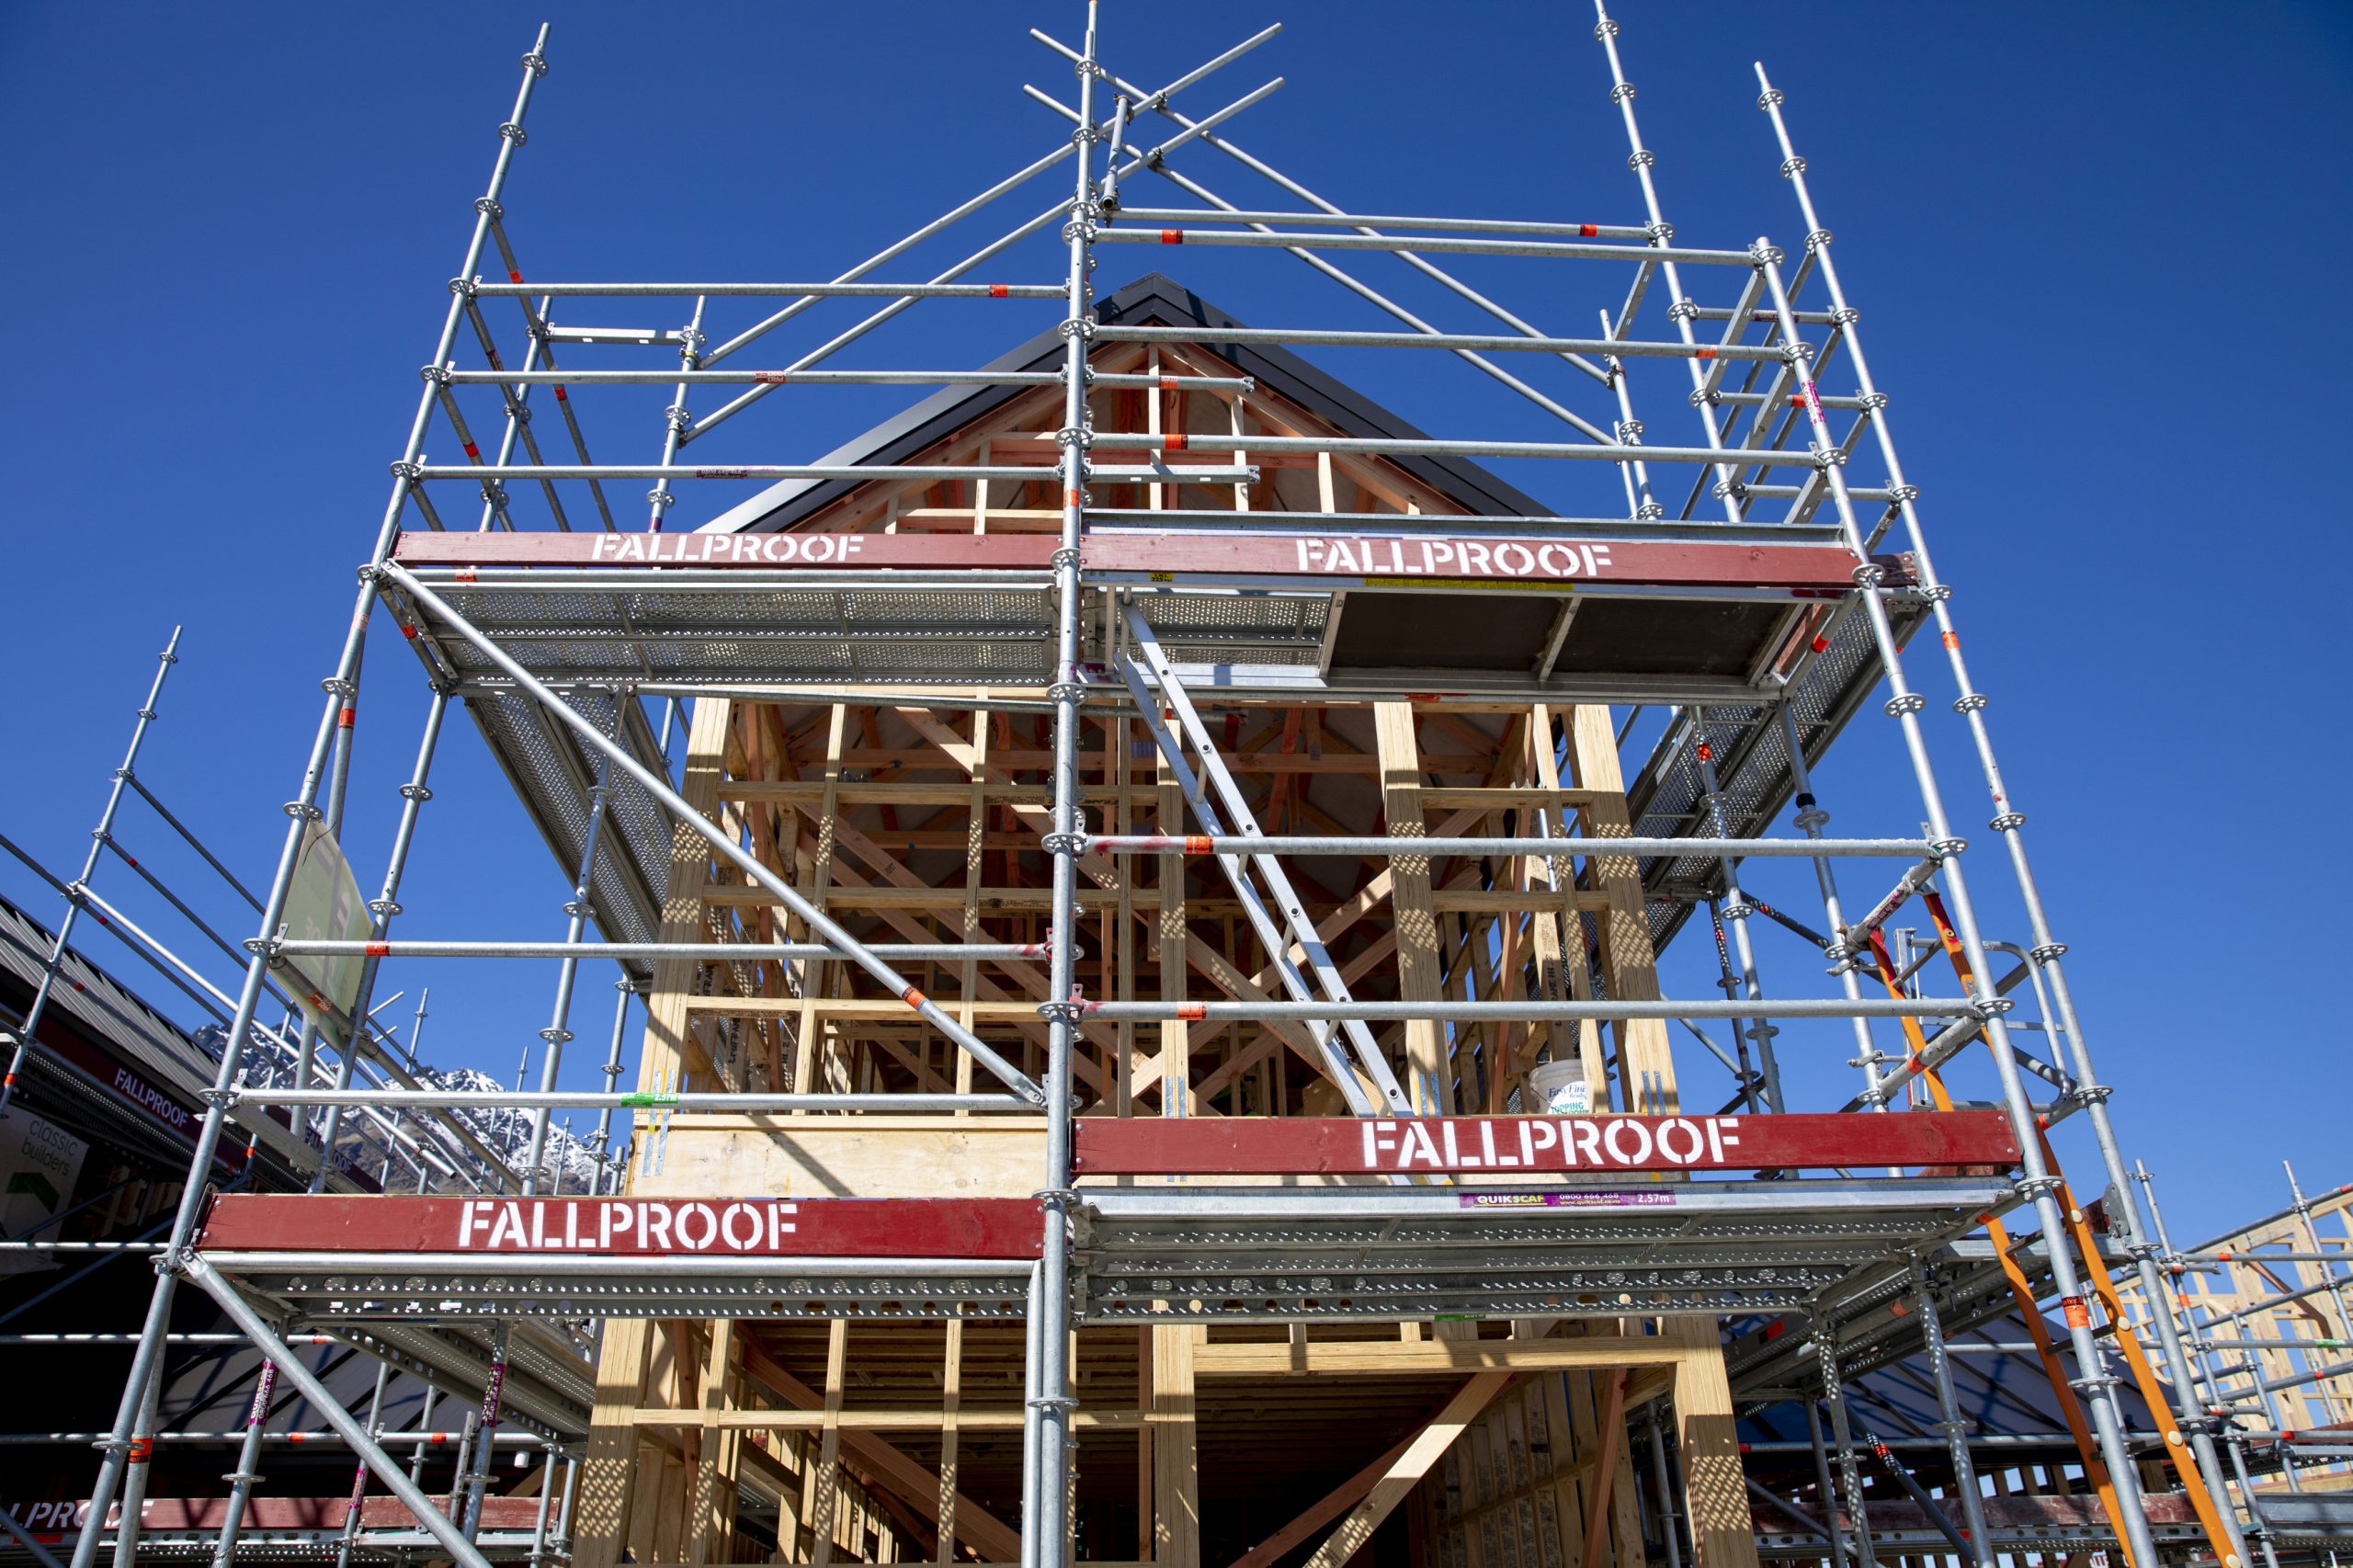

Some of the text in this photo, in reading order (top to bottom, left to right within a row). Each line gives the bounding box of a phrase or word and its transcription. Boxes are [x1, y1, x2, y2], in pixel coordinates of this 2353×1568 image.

[591, 533, 864, 562] FALLPROOF
[1295, 538, 1613, 578] FALLPROOF
[114, 1067, 188, 1128] FALLPROOF
[1568, 1085, 1586, 1093] Fini
[21, 1137, 71, 1177] builders
[29, 1119, 78, 1157] classic
[1363, 1118, 1742, 1169] FALLPROOF
[1477, 1195, 1545, 1204] QUIKSCAF
[1637, 1194, 1670, 1204] 2.57m
[459, 1200, 798, 1252] FALLPROOF
[258, 1400, 267, 1418] 0800
